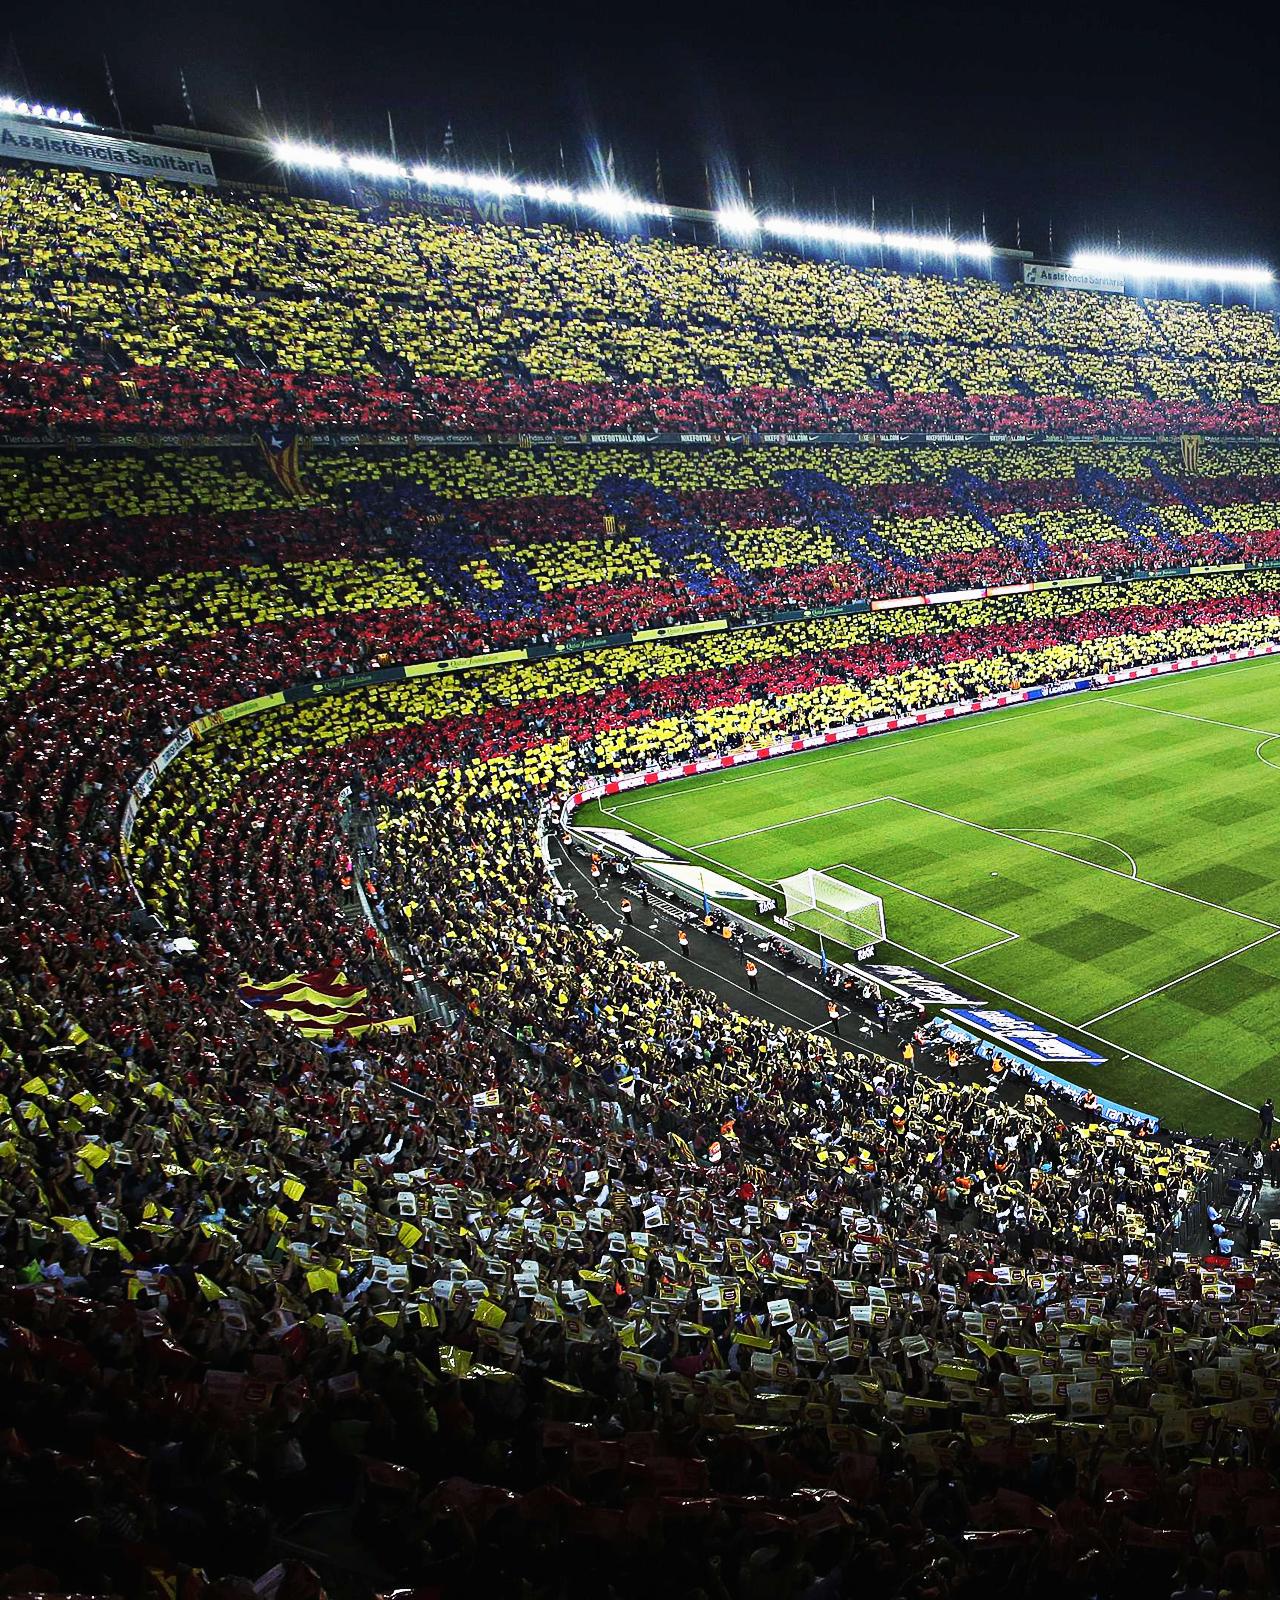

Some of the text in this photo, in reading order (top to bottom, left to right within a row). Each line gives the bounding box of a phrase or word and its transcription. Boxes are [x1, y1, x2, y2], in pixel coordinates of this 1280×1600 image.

[2, 128, 213, 176] Assistència Sanitària
[592, 434, 646, 442] NIKEFOOTBALL.COM
